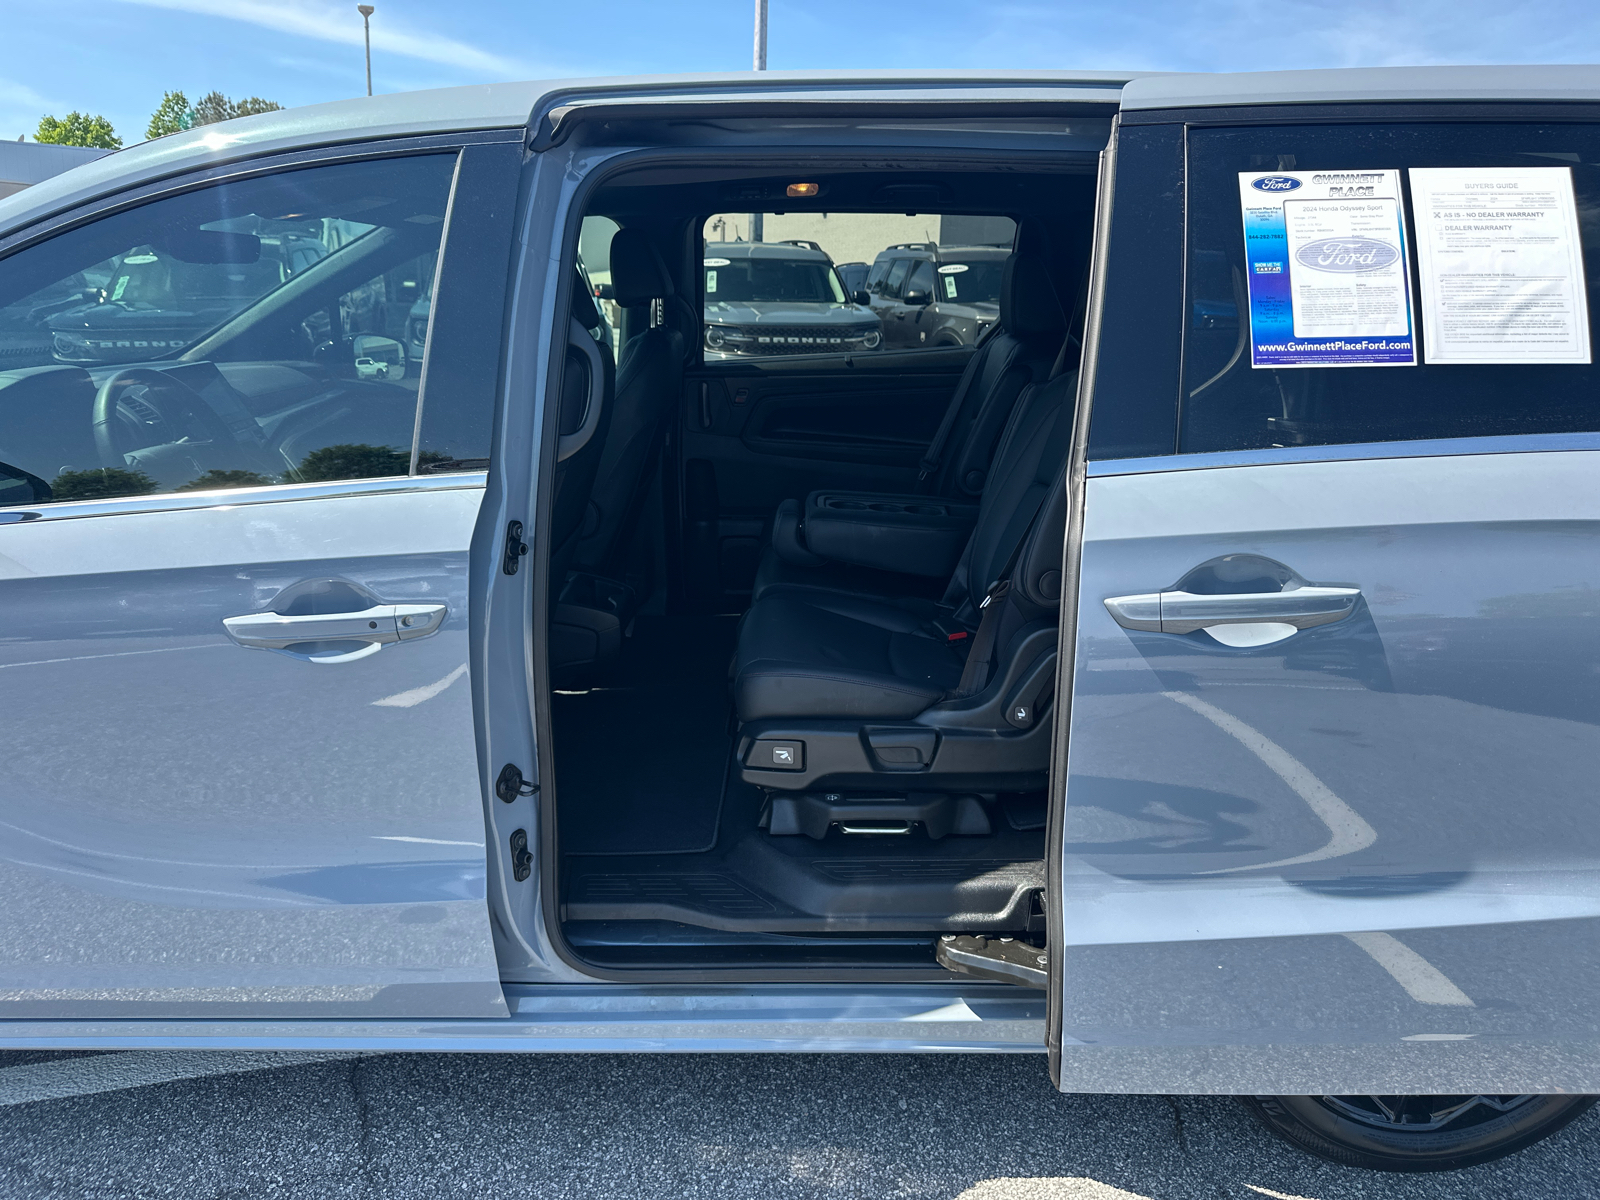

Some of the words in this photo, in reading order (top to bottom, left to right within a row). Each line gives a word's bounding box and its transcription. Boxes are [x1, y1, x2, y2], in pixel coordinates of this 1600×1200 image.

[1261, 178, 1292, 190] Ford
[1312, 173, 1385, 185] GWINNETT
[1328, 186, 1375, 197] PLACE
[1318, 242, 1377, 266] Ford
[99, 340, 192, 349] BRONC
[758, 336, 841, 344] BRONCO
[1257, 339, 1411, 353] www.GwinnettPlaceFord.com
